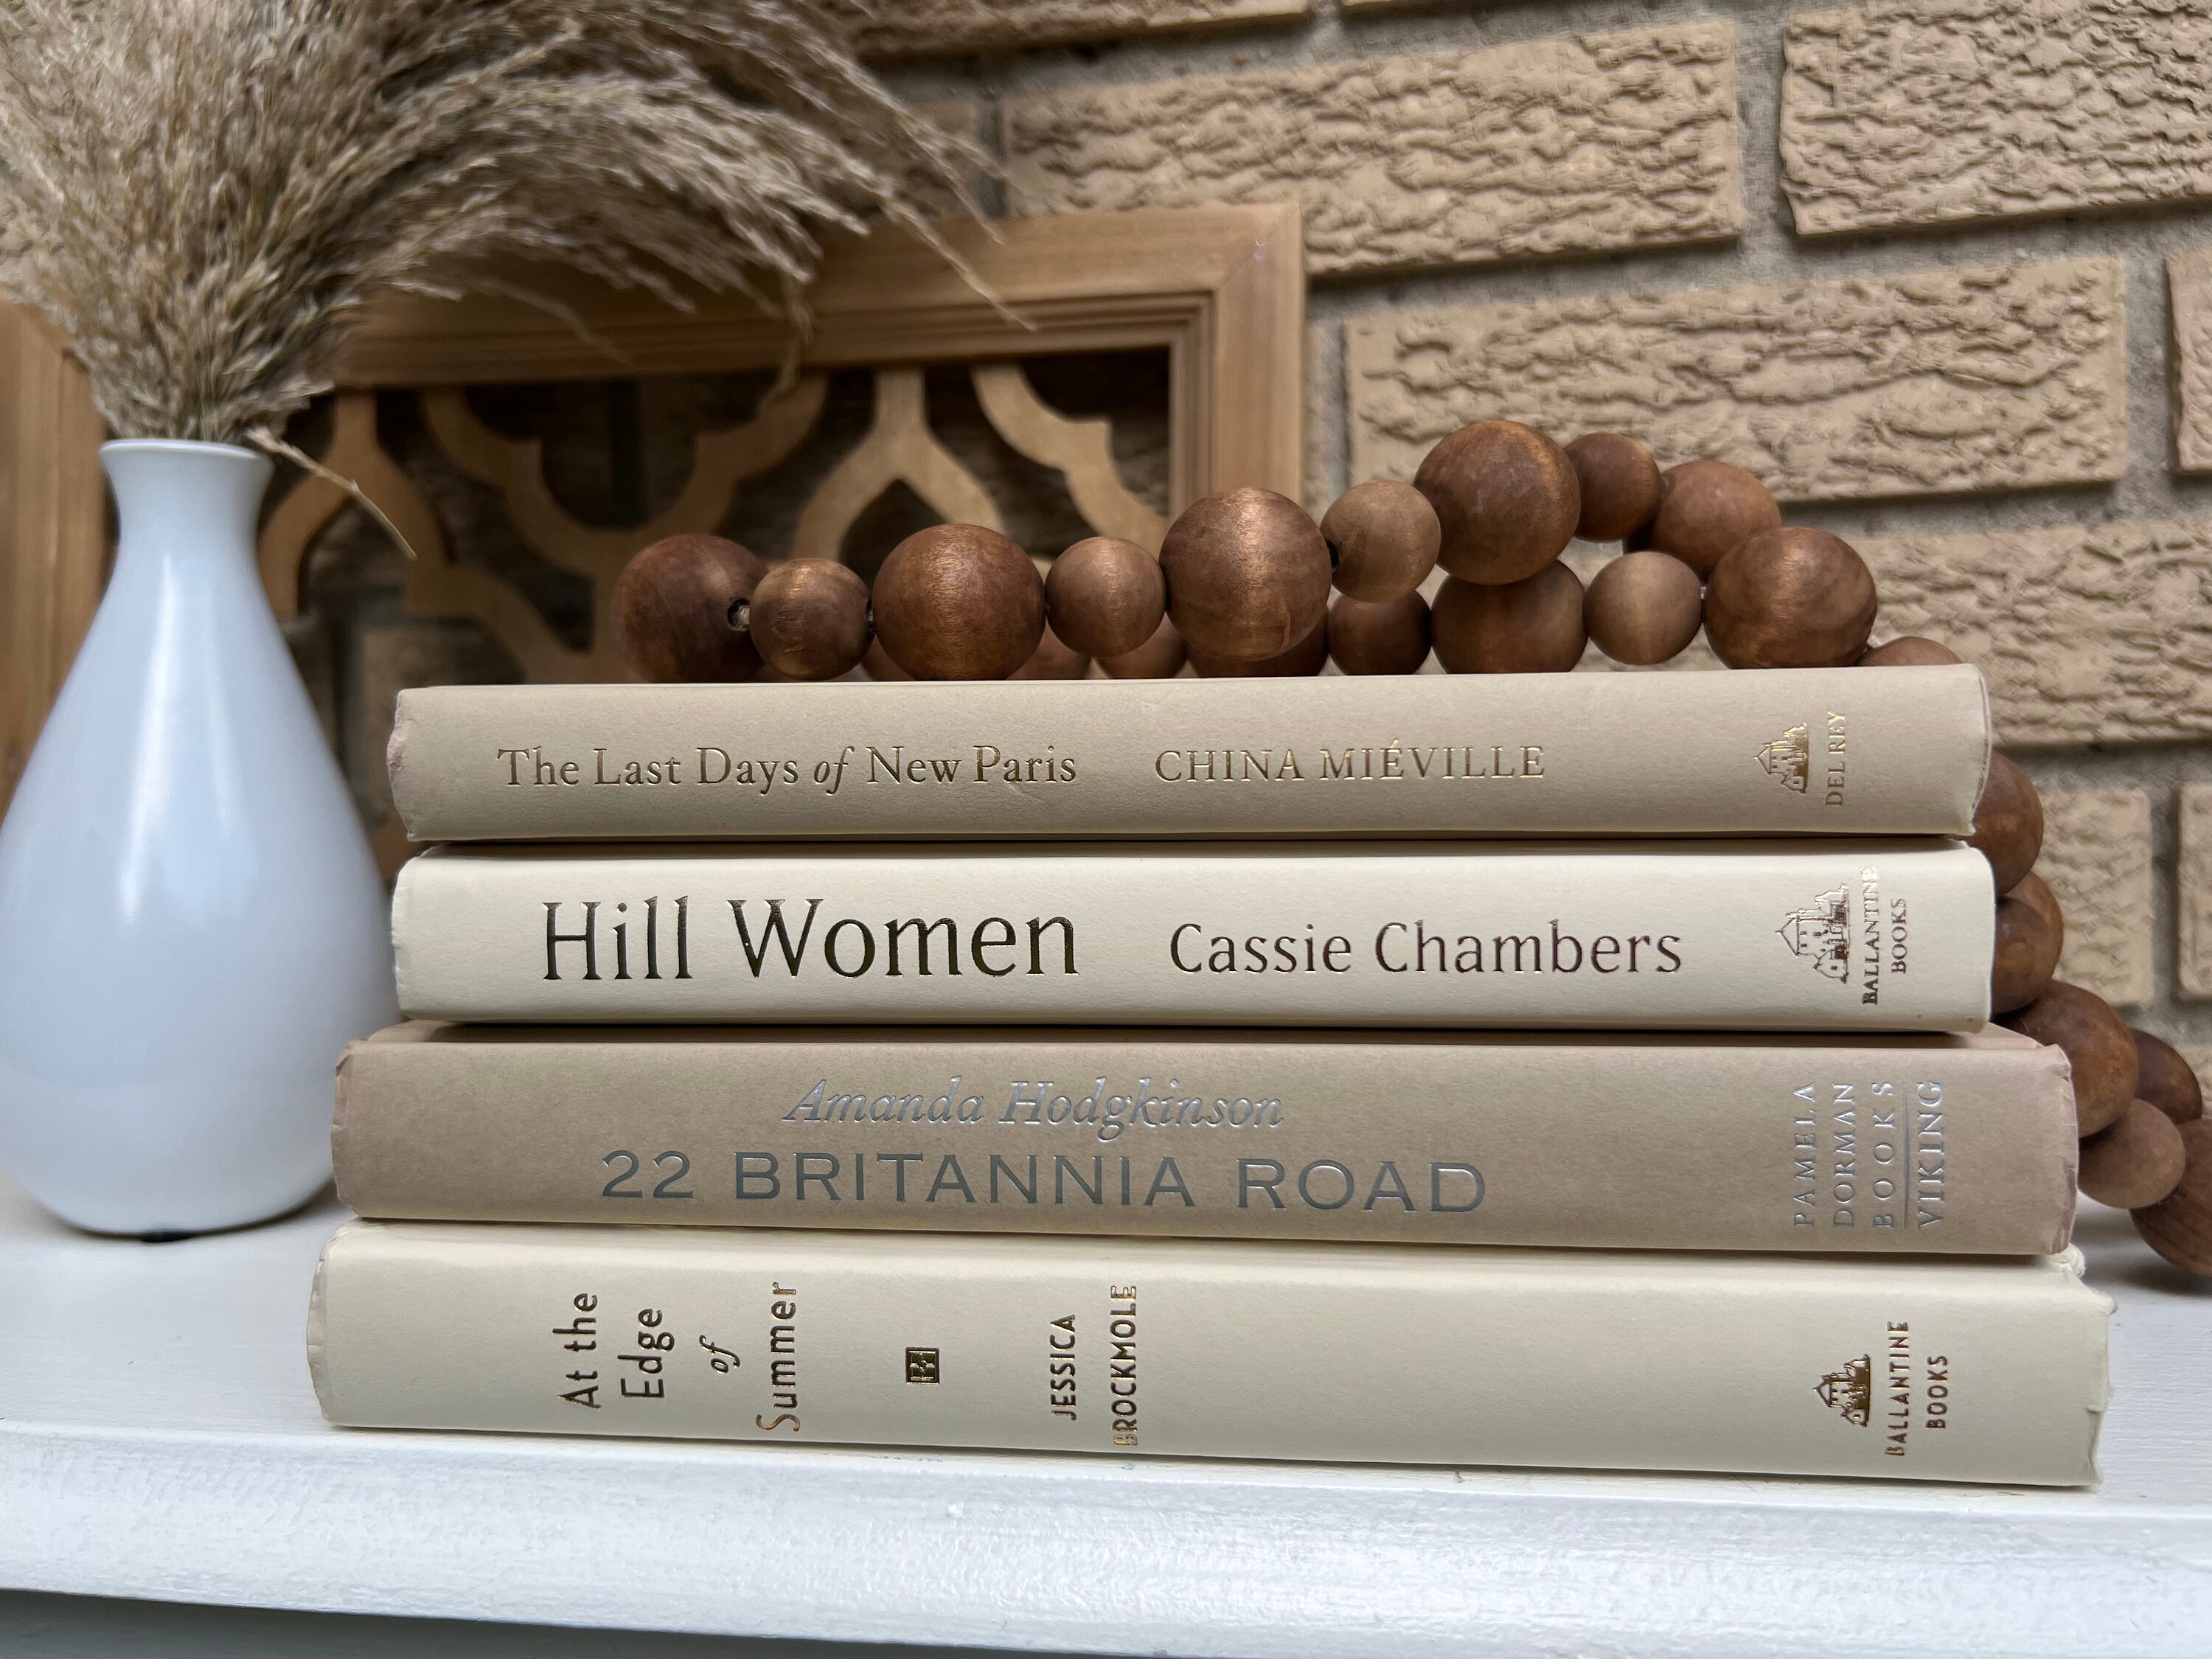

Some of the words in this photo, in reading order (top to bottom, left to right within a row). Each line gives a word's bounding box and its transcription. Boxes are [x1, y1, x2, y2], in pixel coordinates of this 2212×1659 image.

[497, 745, 580, 787] The
[593, 747, 682, 786] Last
[696, 746, 799, 795] Days
[813, 745, 856, 796] of
[866, 745, 962, 785] New
[973, 745, 1078, 785] Paris
[1154, 748, 1305, 783] CHINA
[1319, 738, 1545, 781] MIÉVILLE
[1826, 710, 1846, 755] REY
[1825, 760, 1846, 807] DEL
[542, 895, 694, 981] Hill
[726, 897, 1081, 979] Women
[1169, 922, 1353, 974] Cassie
[1374, 918, 1683, 974] Chambers
[1860, 866, 1880, 1006] BALLANTINE
[1890, 897, 1908, 974] BOOKS
[782, 1075, 985, 1124] Amanda
[998, 1076, 1284, 1143] Hodgkinson
[601, 1150, 694, 1200] 22
[733, 1151, 1195, 1207] BRITANNIA
[1236, 1158, 1486, 1213] ROAD
[1792, 1081, 1817, 1228] PAMELA
[1832, 1082, 1856, 1228] DORMAN
[1871, 1081, 1896, 1228] BOOKS
[1916, 1081, 1946, 1229] VIKING
[552, 1292, 598, 1352] the
[617, 1307, 675, 1399] Edge
[698, 1335, 741, 1374] of
[755, 1281, 801, 1433] Summer
[556, 1367, 602, 1410] At
[1049, 1314, 1077, 1422] JESSICA
[1109, 1284, 1138, 1447] BROCKMOLE
[1885, 1321, 1909, 1457] BALLANTINE
[1926, 1354, 1949, 1430] BOOKS
